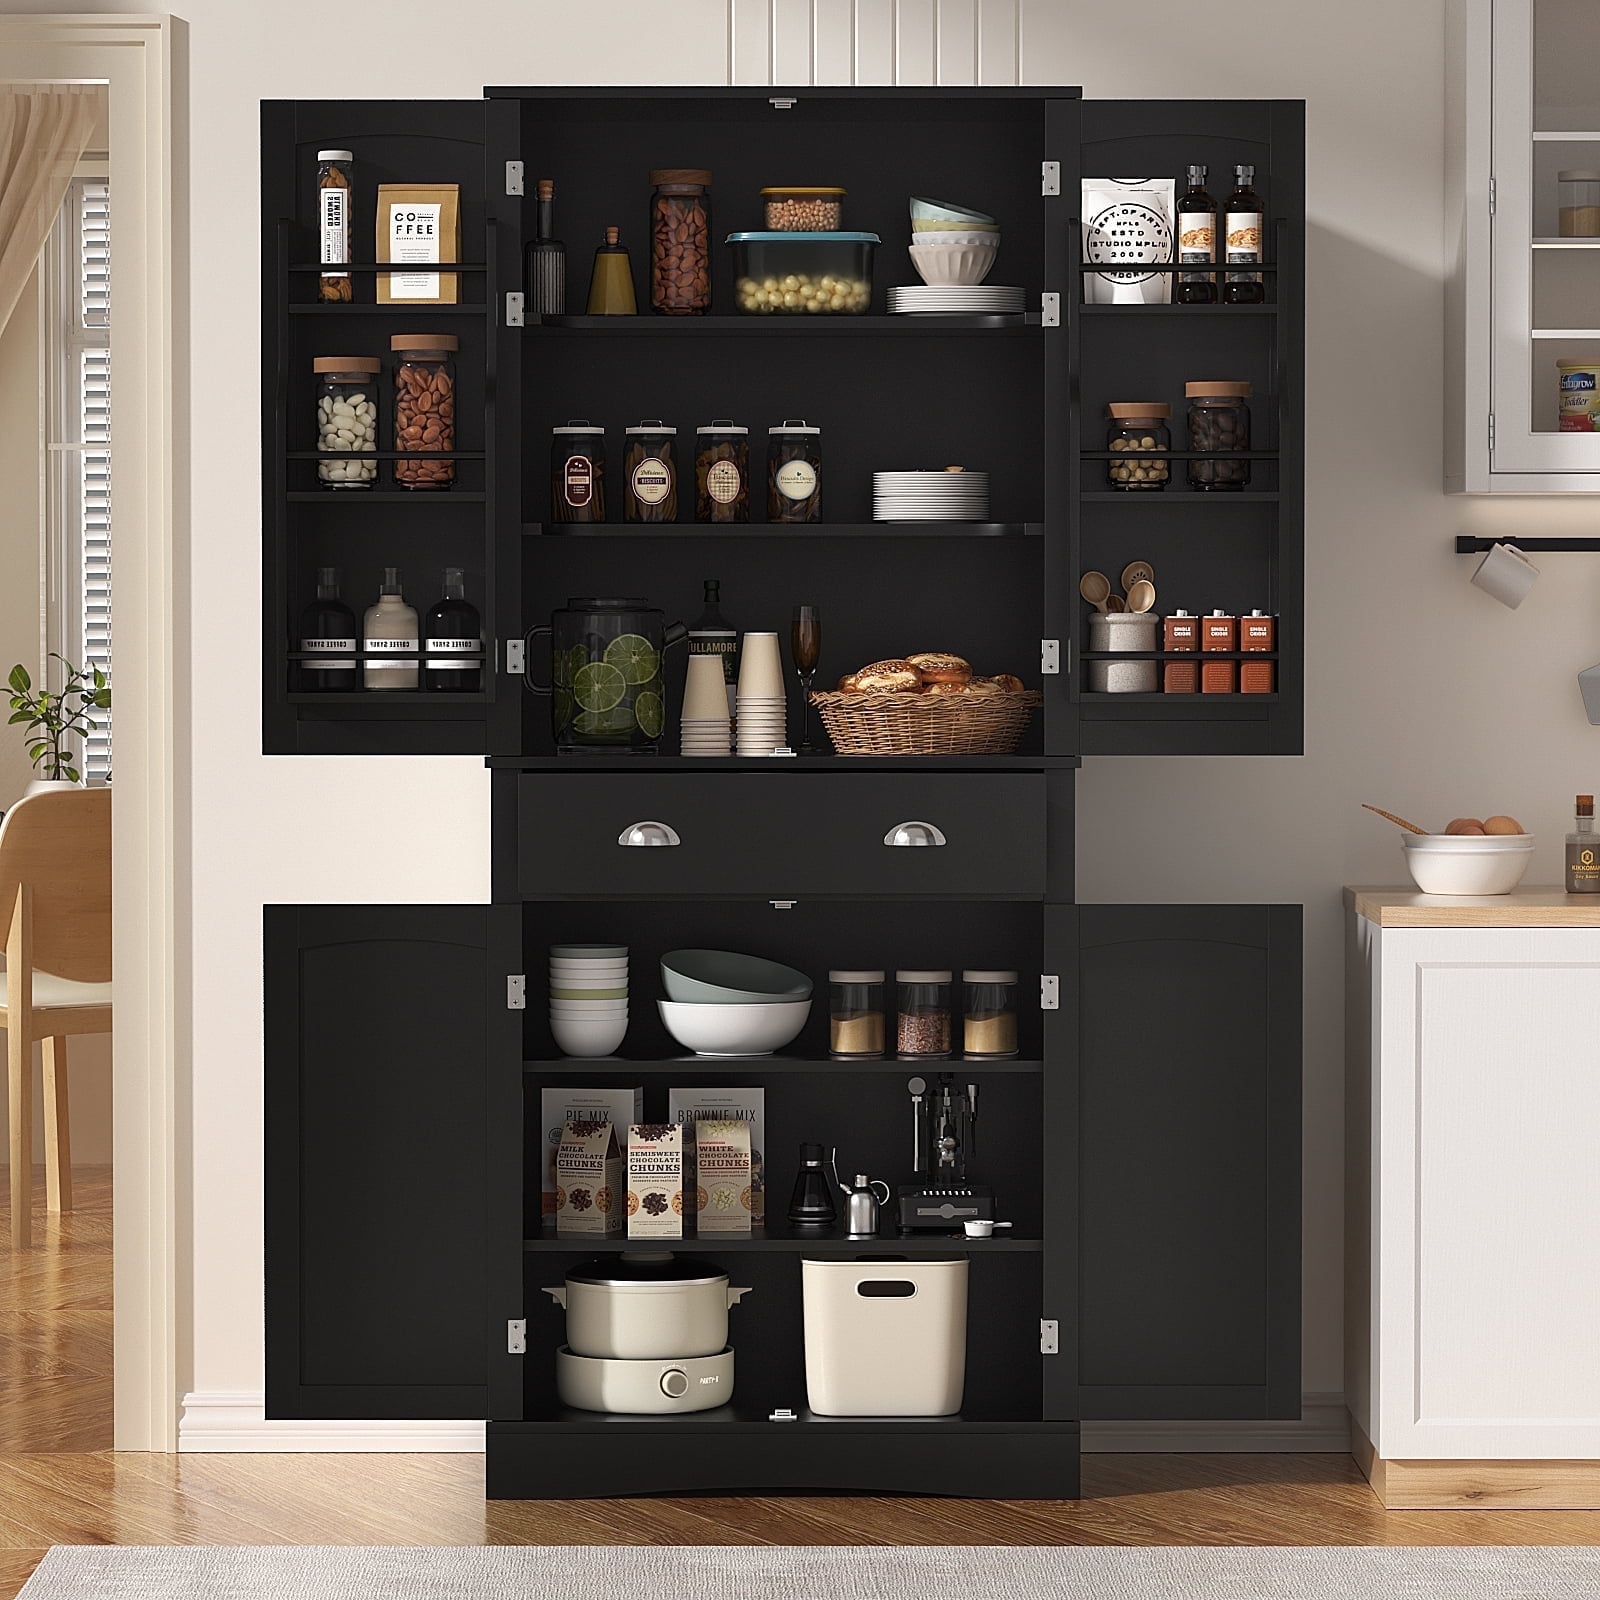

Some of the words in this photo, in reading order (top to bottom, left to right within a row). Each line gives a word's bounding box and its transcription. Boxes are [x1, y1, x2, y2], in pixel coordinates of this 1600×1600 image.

[394, 212, 416, 222] CO
[396, 224, 434, 235] FFEE
[1092, 240, 1132, 248] STUDIO
[566, 1110, 583, 1121] PIE
[589, 1110, 610, 1122] MIX
[677, 1109, 730, 1122] BROWNIE
[735, 1109, 757, 1122] MIX
[560, 1145, 585, 1153] MILK
[558, 1152, 605, 1160] CHOCOLATE
[558, 1159, 604, 1168] CHUNKS
[630, 1164, 681, 1172] CHUNKS
[699, 1159, 750, 1168] CHUNKS
